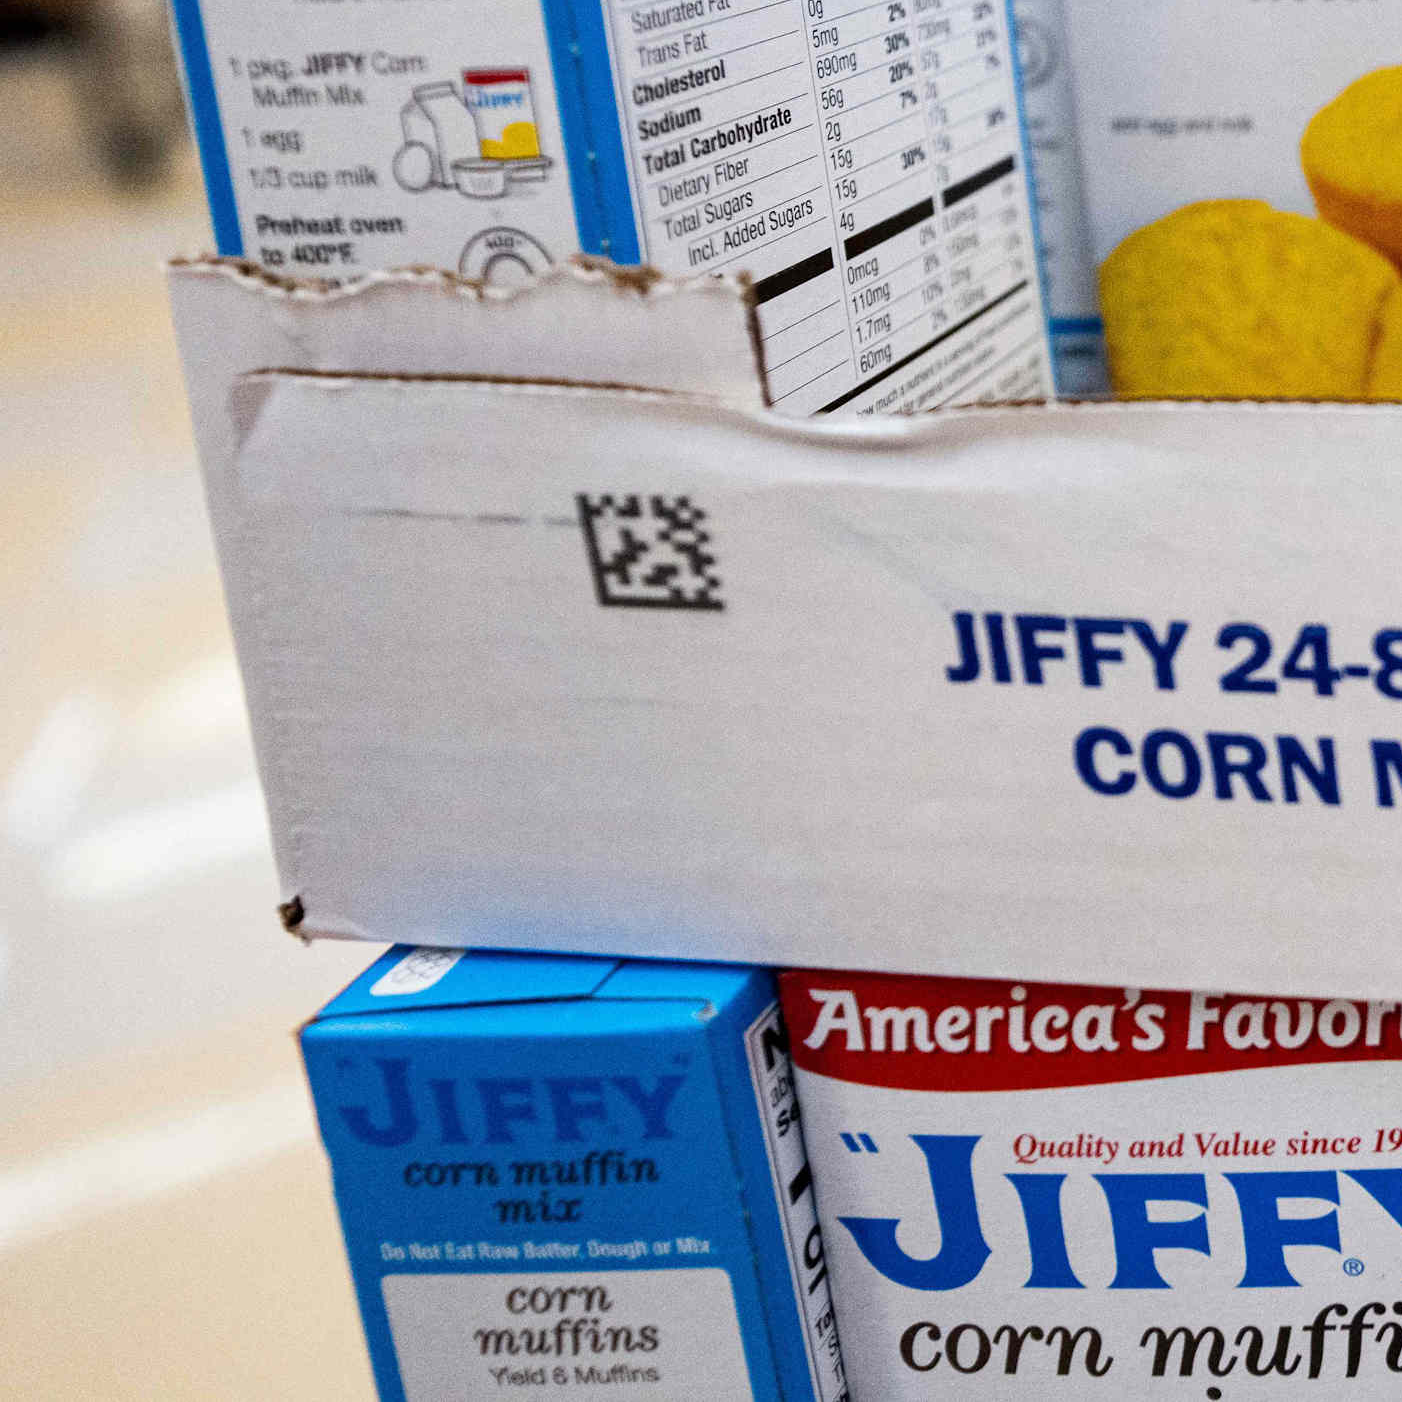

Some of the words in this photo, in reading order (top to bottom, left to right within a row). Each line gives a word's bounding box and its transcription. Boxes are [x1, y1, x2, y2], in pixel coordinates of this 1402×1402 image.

[632, 59, 726, 106] Cholesterol
[811, 26, 839, 48] 5mg
[637, 41, 680, 68] Trans
[684, 30, 709, 53] Fat
[638, 106, 701, 141] Sodium
[816, 51, 857, 79] 690mg
[643, 144, 686, 175] Total
[691, 107, 792, 159] Carbohydrate
[820, 87, 844, 110] 56g
[658, 173, 710, 207] Dietary
[714, 157, 749, 186] Fiber
[825, 120, 841, 142] 2g
[664, 212, 700, 241] Total
[704, 192, 754, 225] Sugars
[829, 147, 853, 171] 15g
[688, 237, 719, 267] Incl.
[724, 216, 766, 251] Added
[769, 198, 814, 231] Sugars
[835, 178, 858, 200] 15g
[943, 610, 1191, 691] JIFFY
[1072, 725, 1342, 808] CORN
[803, 985, 1167, 1056] America's
[403, 1157, 500, 1189] corn
[511, 1149, 661, 1188] muffin
[1011, 1132, 1120, 1166] Quality
[1127, 1134, 1185, 1159] and
[1193, 1131, 1277, 1158] Value
[1284, 1129, 1362, 1157] since
[493, 1190, 585, 1225] mix
[505, 1285, 614, 1315] corn
[473, 1318, 660, 1356] muffins
[896, 1317, 1114, 1378] corn
[489, 1366, 545, 1386] Yield
[573, 1362, 660, 1385] Muffins
